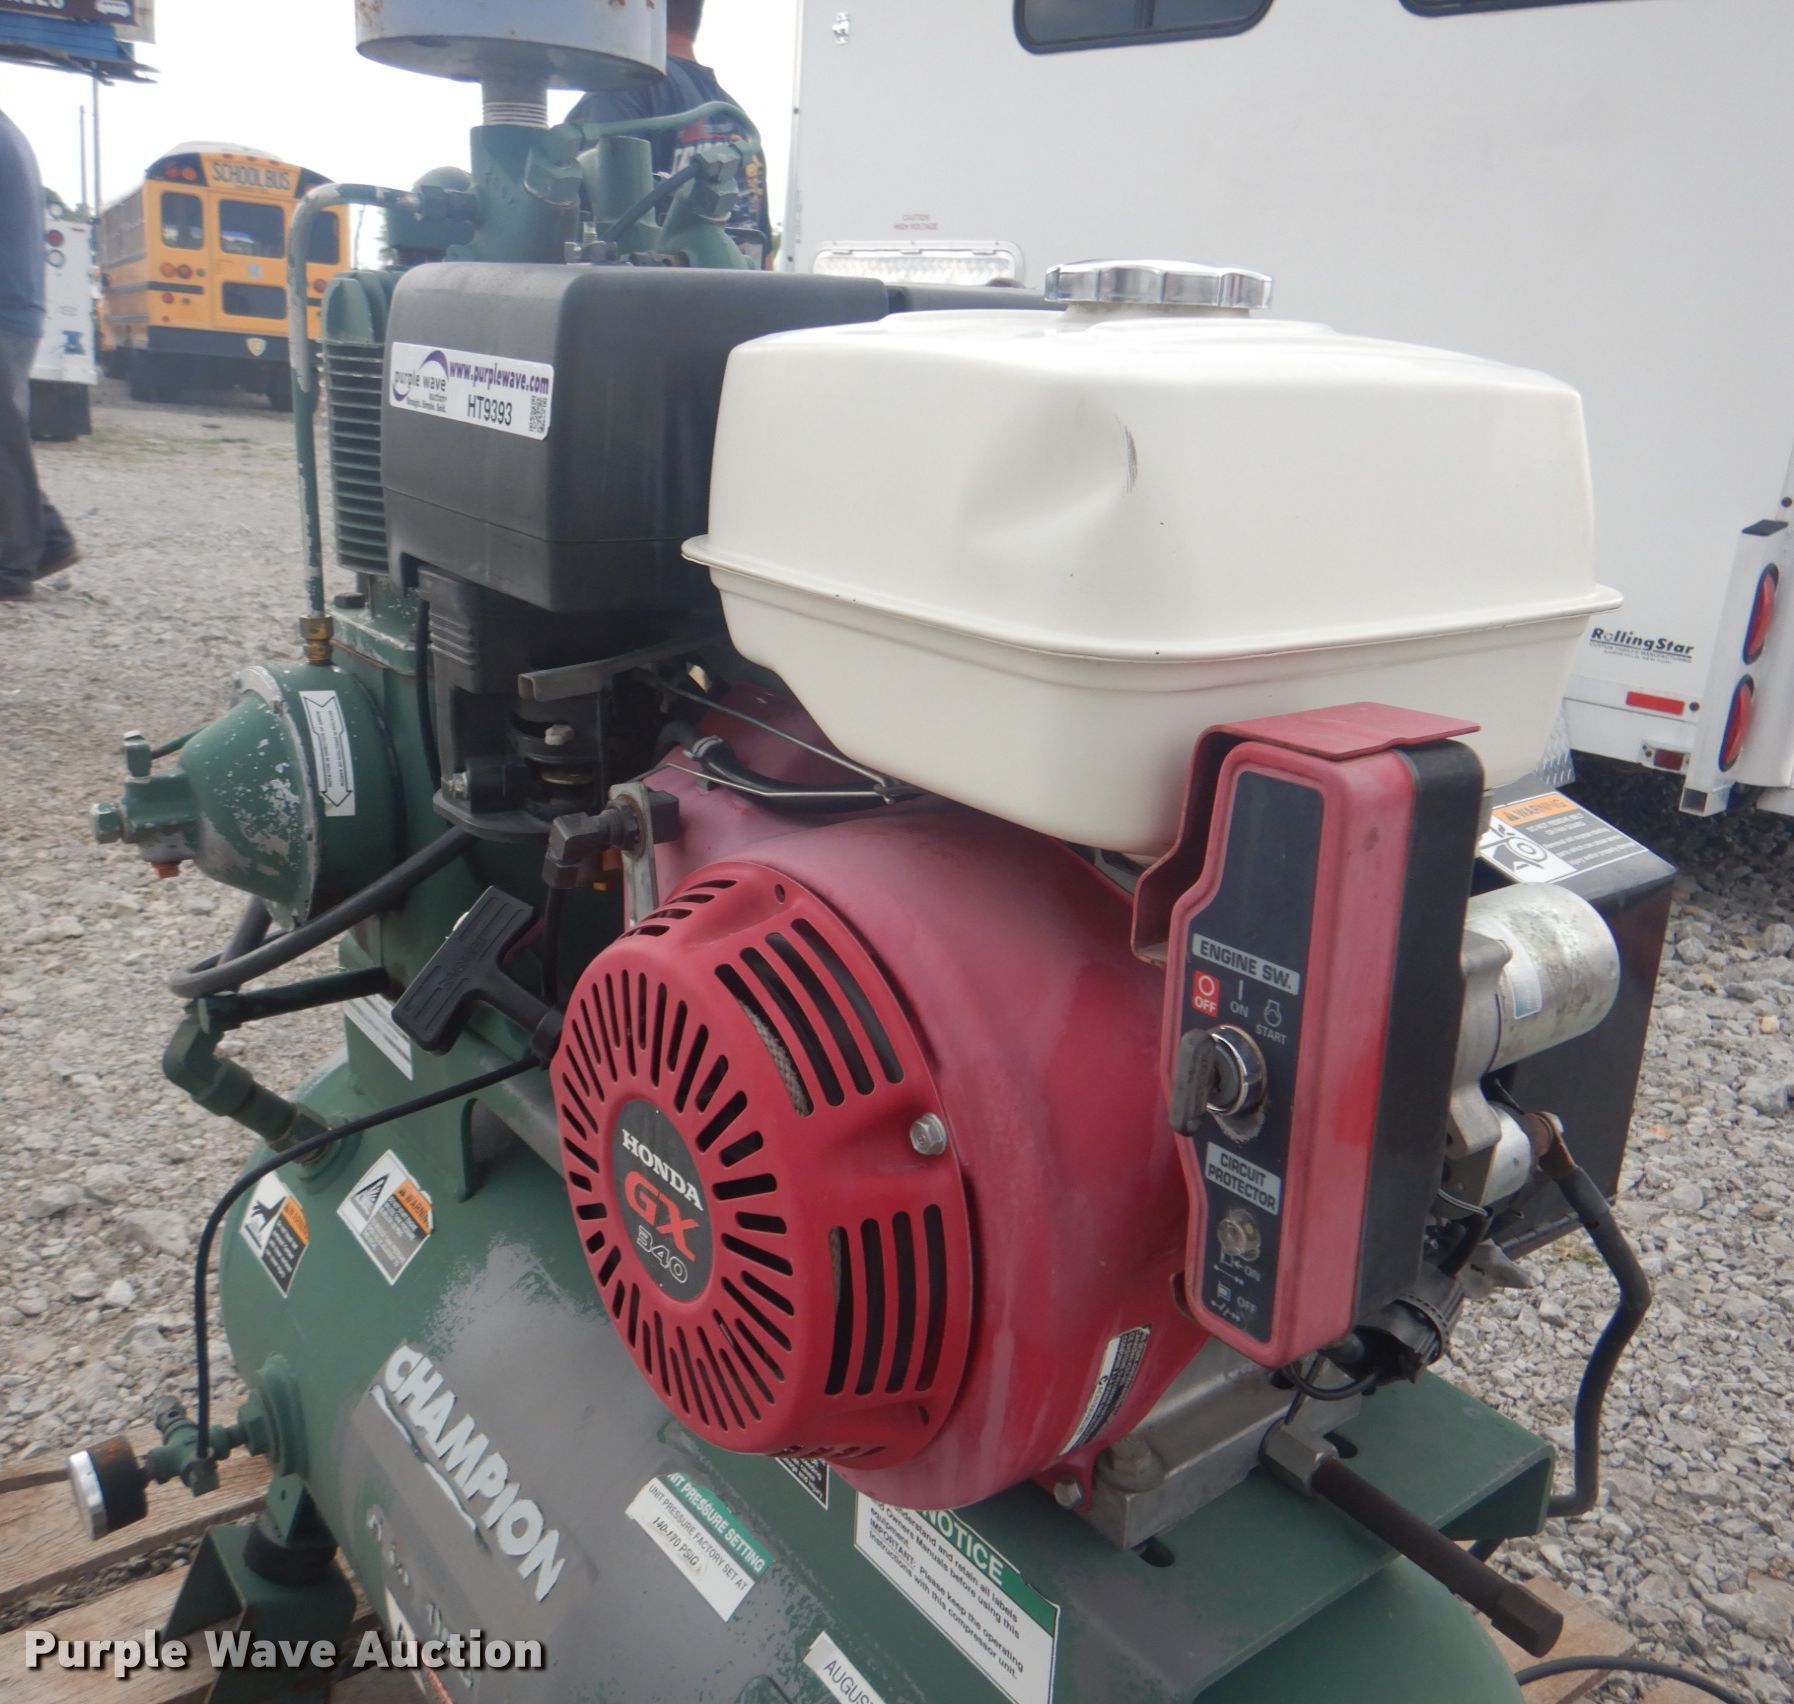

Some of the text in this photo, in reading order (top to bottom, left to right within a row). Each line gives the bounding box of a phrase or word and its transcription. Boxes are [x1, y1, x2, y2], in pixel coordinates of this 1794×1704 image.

[212, 161, 291, 191] SCHOOL BUS
[394, 370, 447, 393] purple wave
[449, 361, 549, 394] www.purplewave.com
[467, 394, 513, 426] HT9393
[1199, 939, 1292, 990] ENGINE SW.
[1194, 995, 1217, 1013] OFF
[1229, 1000, 1249, 1018] ON
[1255, 1024, 1288, 1046] START
[621, 1128, 704, 1212] HONDA
[1207, 1163, 1276, 1211] PROTECTOR
[1220, 1152, 1267, 1187] CIRCUIT
[624, 1170, 700, 1263] GX
[636, 1225, 688, 1284] 340
[1243, 1264, 1261, 1282] ON
[1237, 1295, 1258, 1314] OFF
[384, 1345, 565, 1602] CHAMPION
[648, 1484, 748, 1592] UNIT PRESSURE FACTORY SET AT
[667, 1472, 766, 1573] NIT PRESSURE SETTING
[678, 1542, 700, 1567] PSIG
[922, 1510, 1004, 1587] NOTICE
[886, 1506, 1020, 1640] Owners Manuals before using this
[938, 1543, 954, 1564] and
[954, 1557, 979, 1585] retain
[979, 1582, 991, 1597] all
[991, 1589, 1018, 1623] labels
[913, 1574, 930, 1596] with
[931, 1588, 947, 1611] this
[948, 1607, 997, 1659] compressor
[998, 1655, 1018, 1680] unit.
[919, 1566, 946, 1597] Please
[947, 1590, 967, 1618] keep
[968, 1610, 982, 1631] the
[982, 1627, 1024, 1674] operating
[823, 1660, 875, 1704] AUGUS
